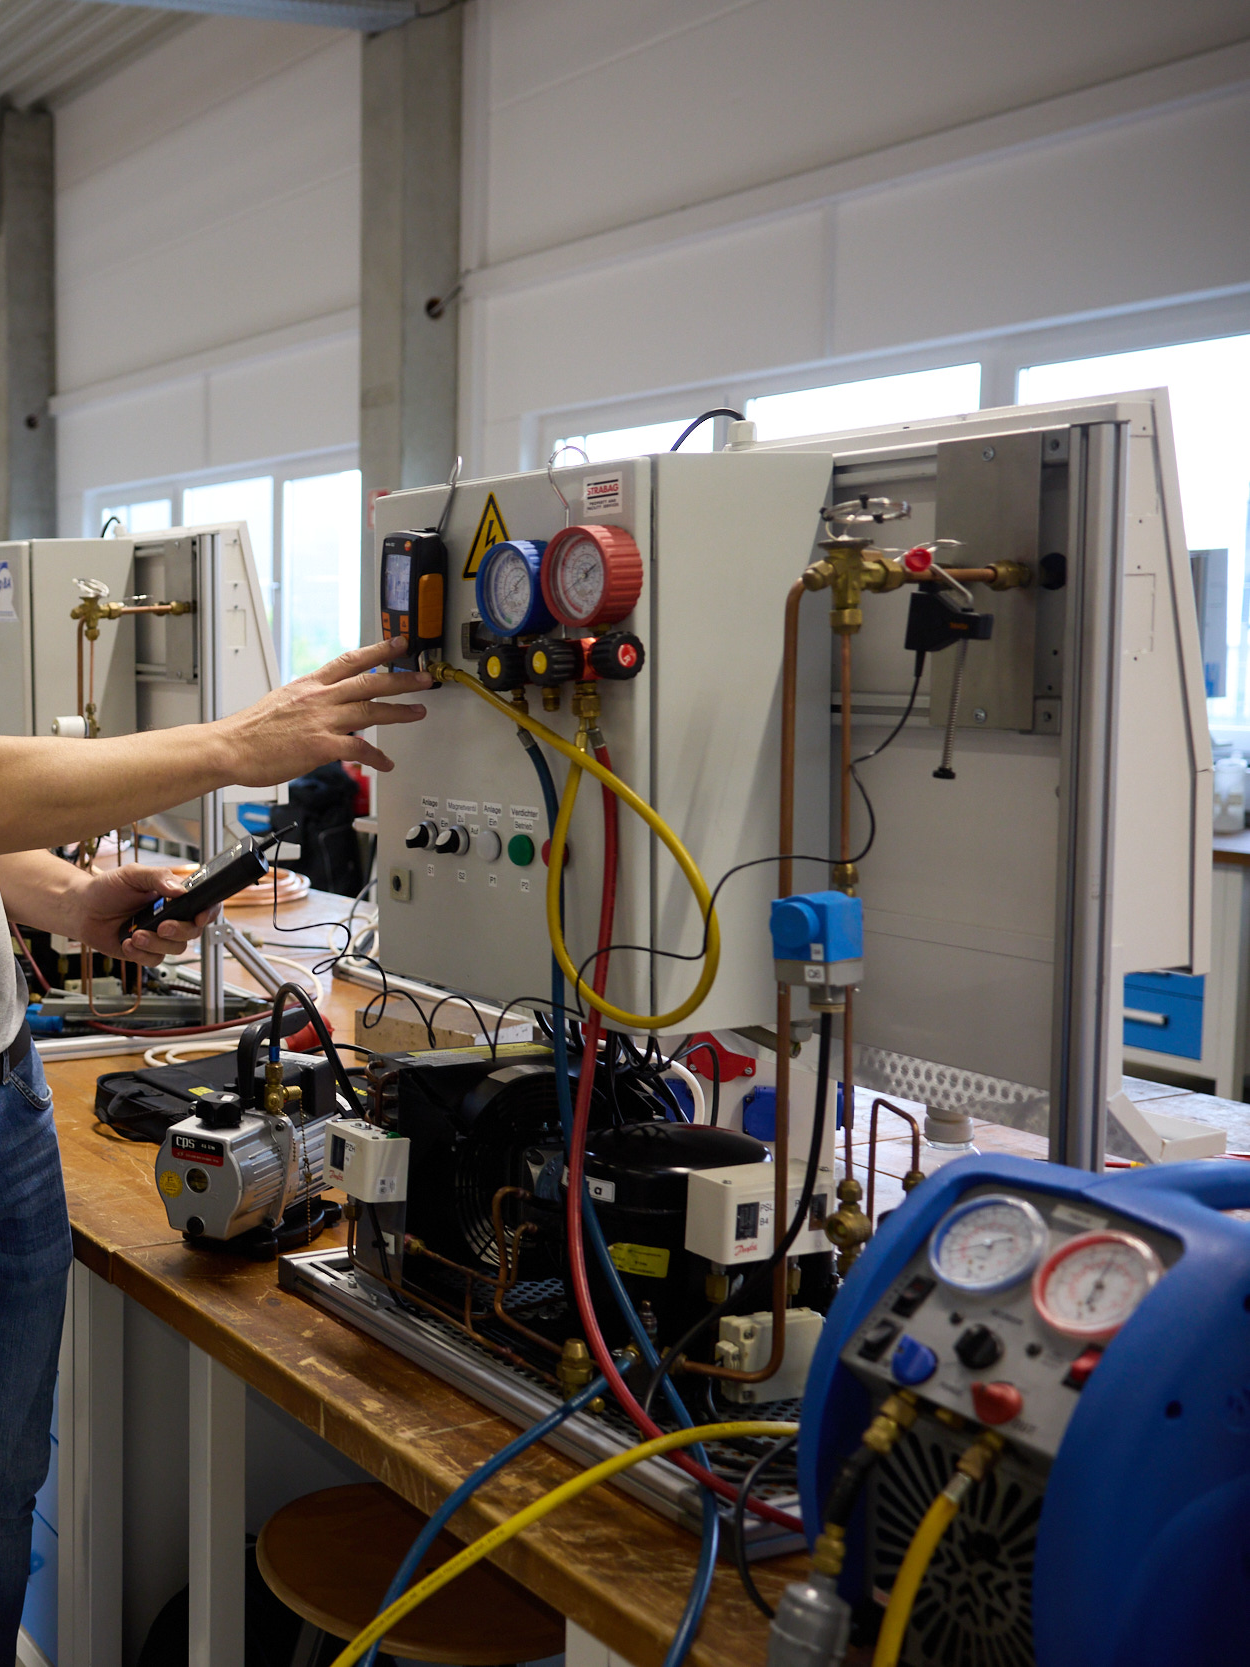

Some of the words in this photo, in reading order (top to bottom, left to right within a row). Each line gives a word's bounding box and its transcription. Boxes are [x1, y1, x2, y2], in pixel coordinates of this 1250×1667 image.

[587, 483, 619, 496] STRABAG
[422, 798, 438, 808] Anlage
[484, 805, 502, 815] Anlage
[489, 818, 498, 827] Ein
[176, 1135, 196, 1149] cps
